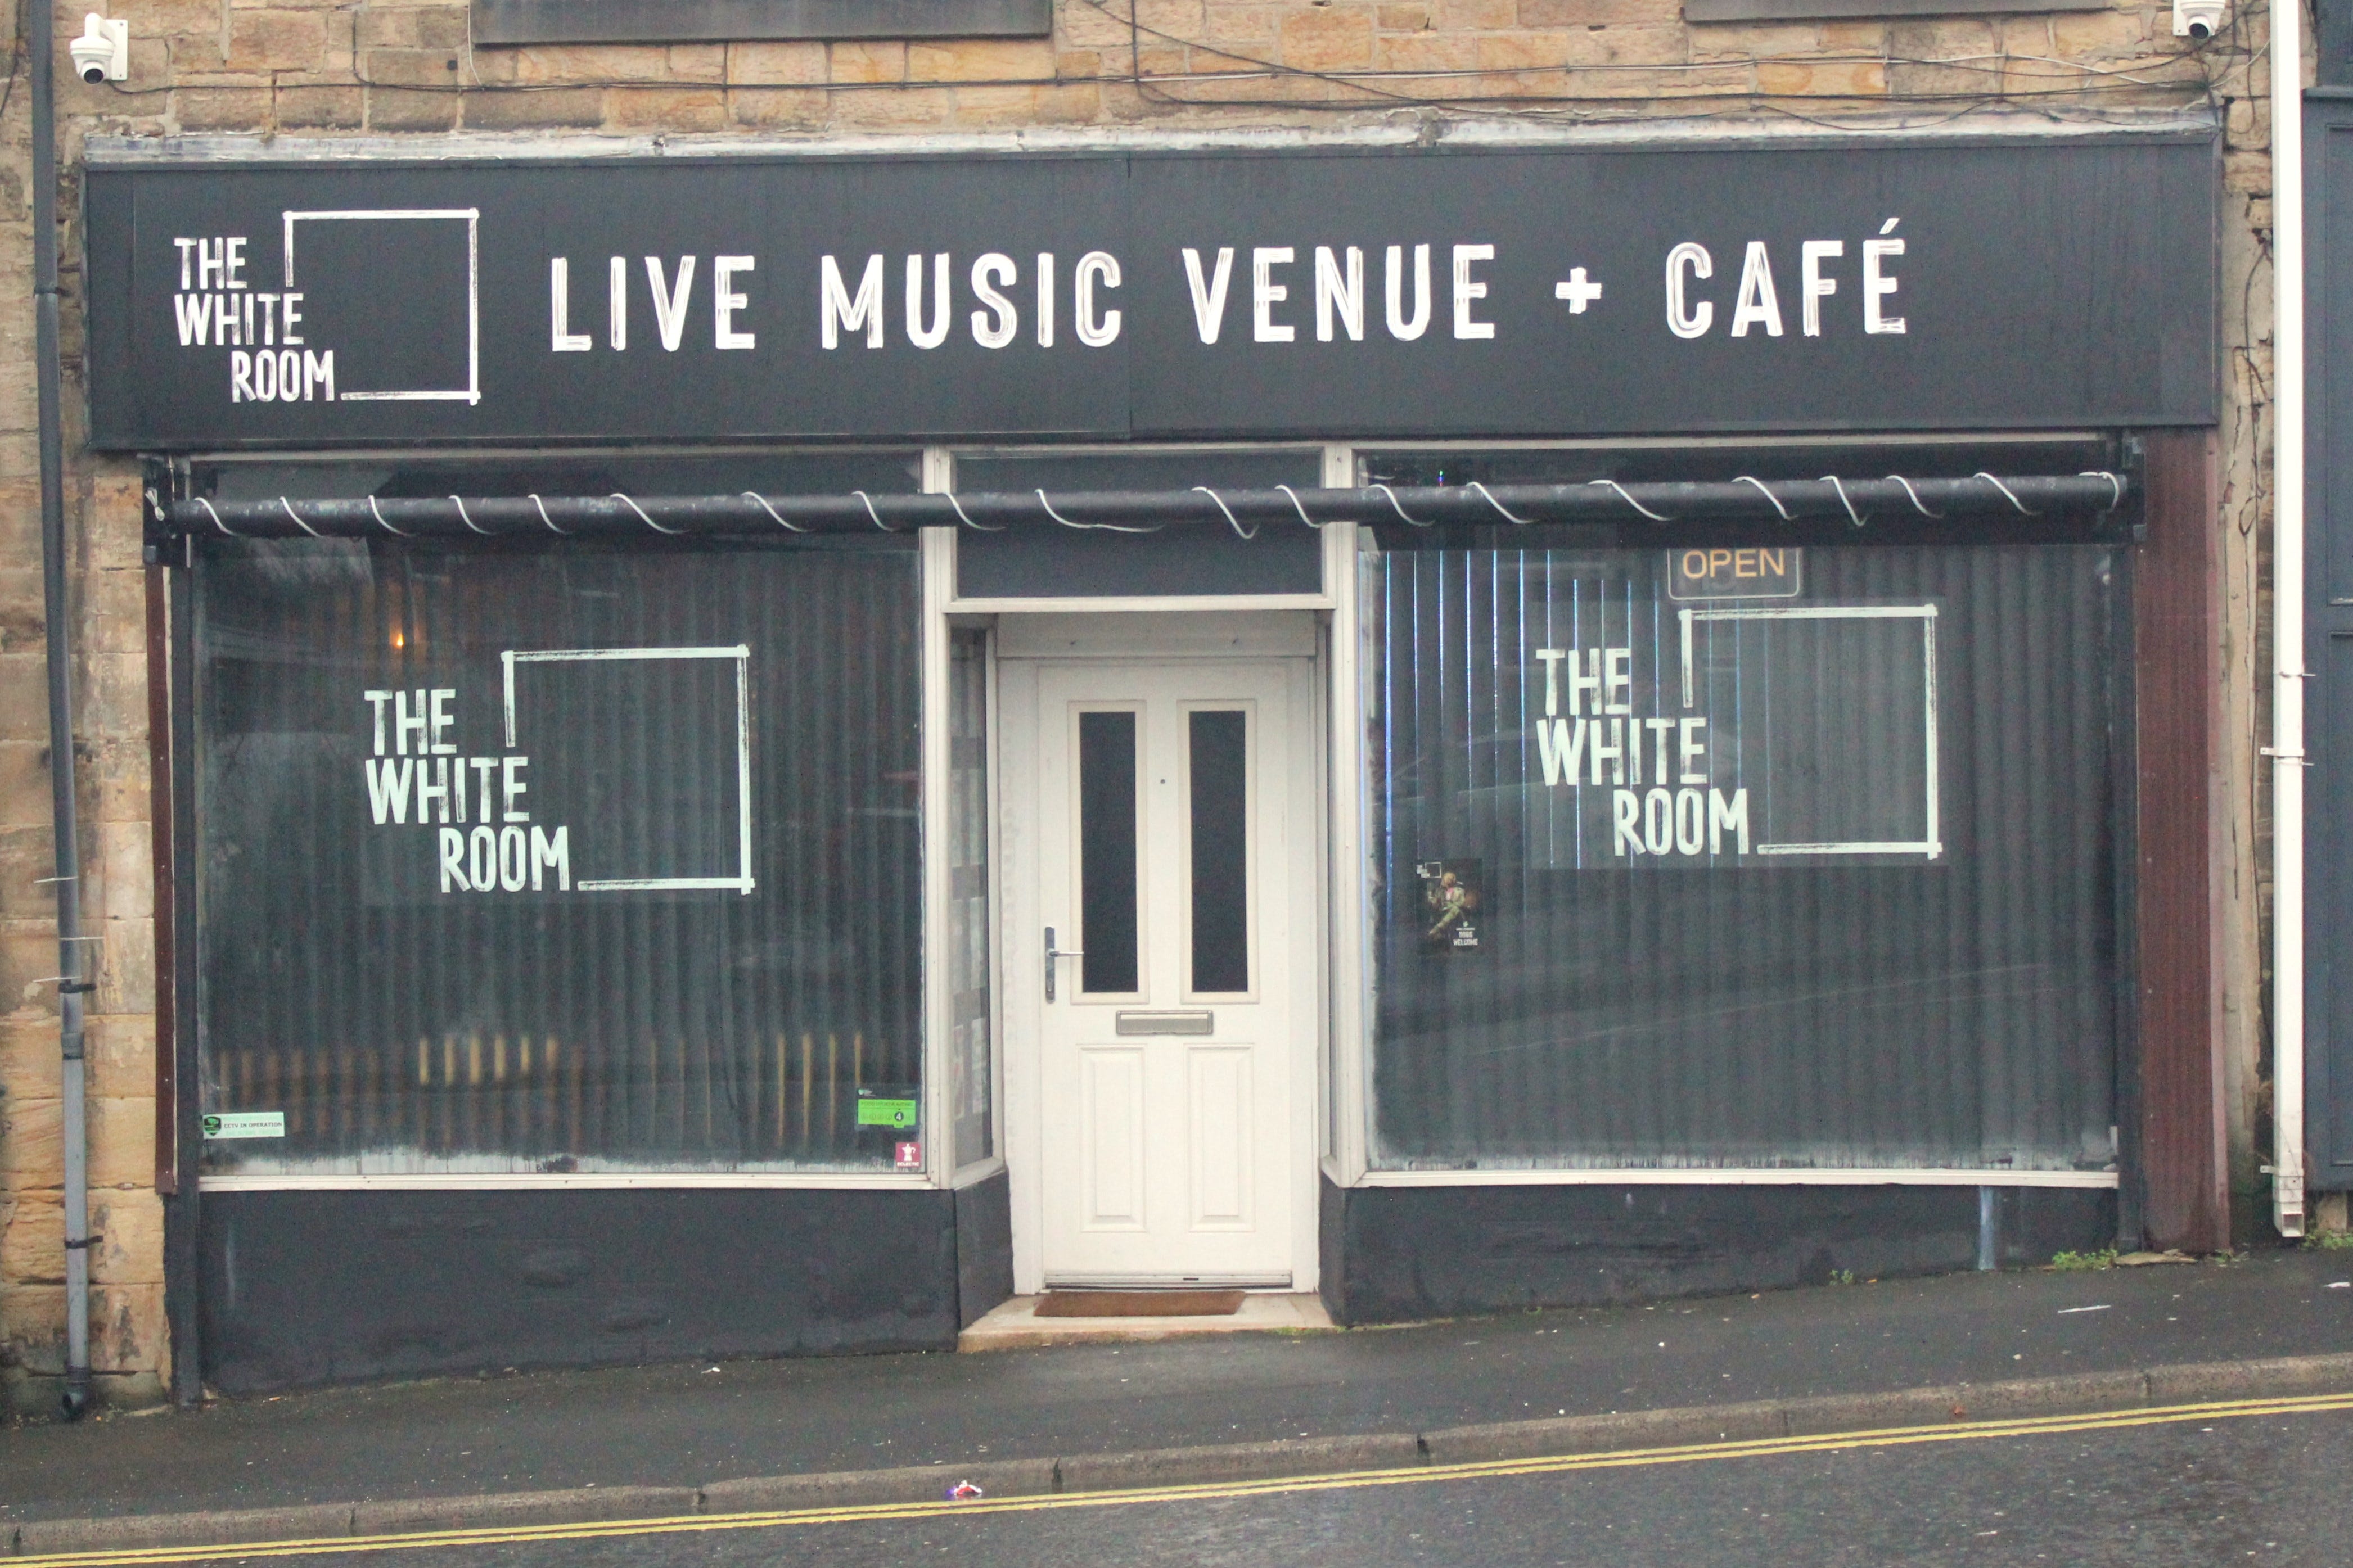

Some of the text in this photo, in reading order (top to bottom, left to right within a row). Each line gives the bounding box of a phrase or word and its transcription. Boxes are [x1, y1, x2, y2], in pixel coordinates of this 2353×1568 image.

[174, 237, 247, 290] THE
[551, 217, 1907, 352] LIVE MUSIC VENUE + CAFÉ
[174, 292, 304, 346] WHITE
[231, 349, 335, 403] ROOM
[1682, 548, 1785, 579] OPEN
[1535, 648, 1631, 715] THE
[364, 689, 457, 756] THE
[1536, 717, 1707, 786] WHITE
[365, 757, 530, 824] WHITE
[1613, 788, 1749, 856] ROOM
[439, 825, 570, 893] ROOM
